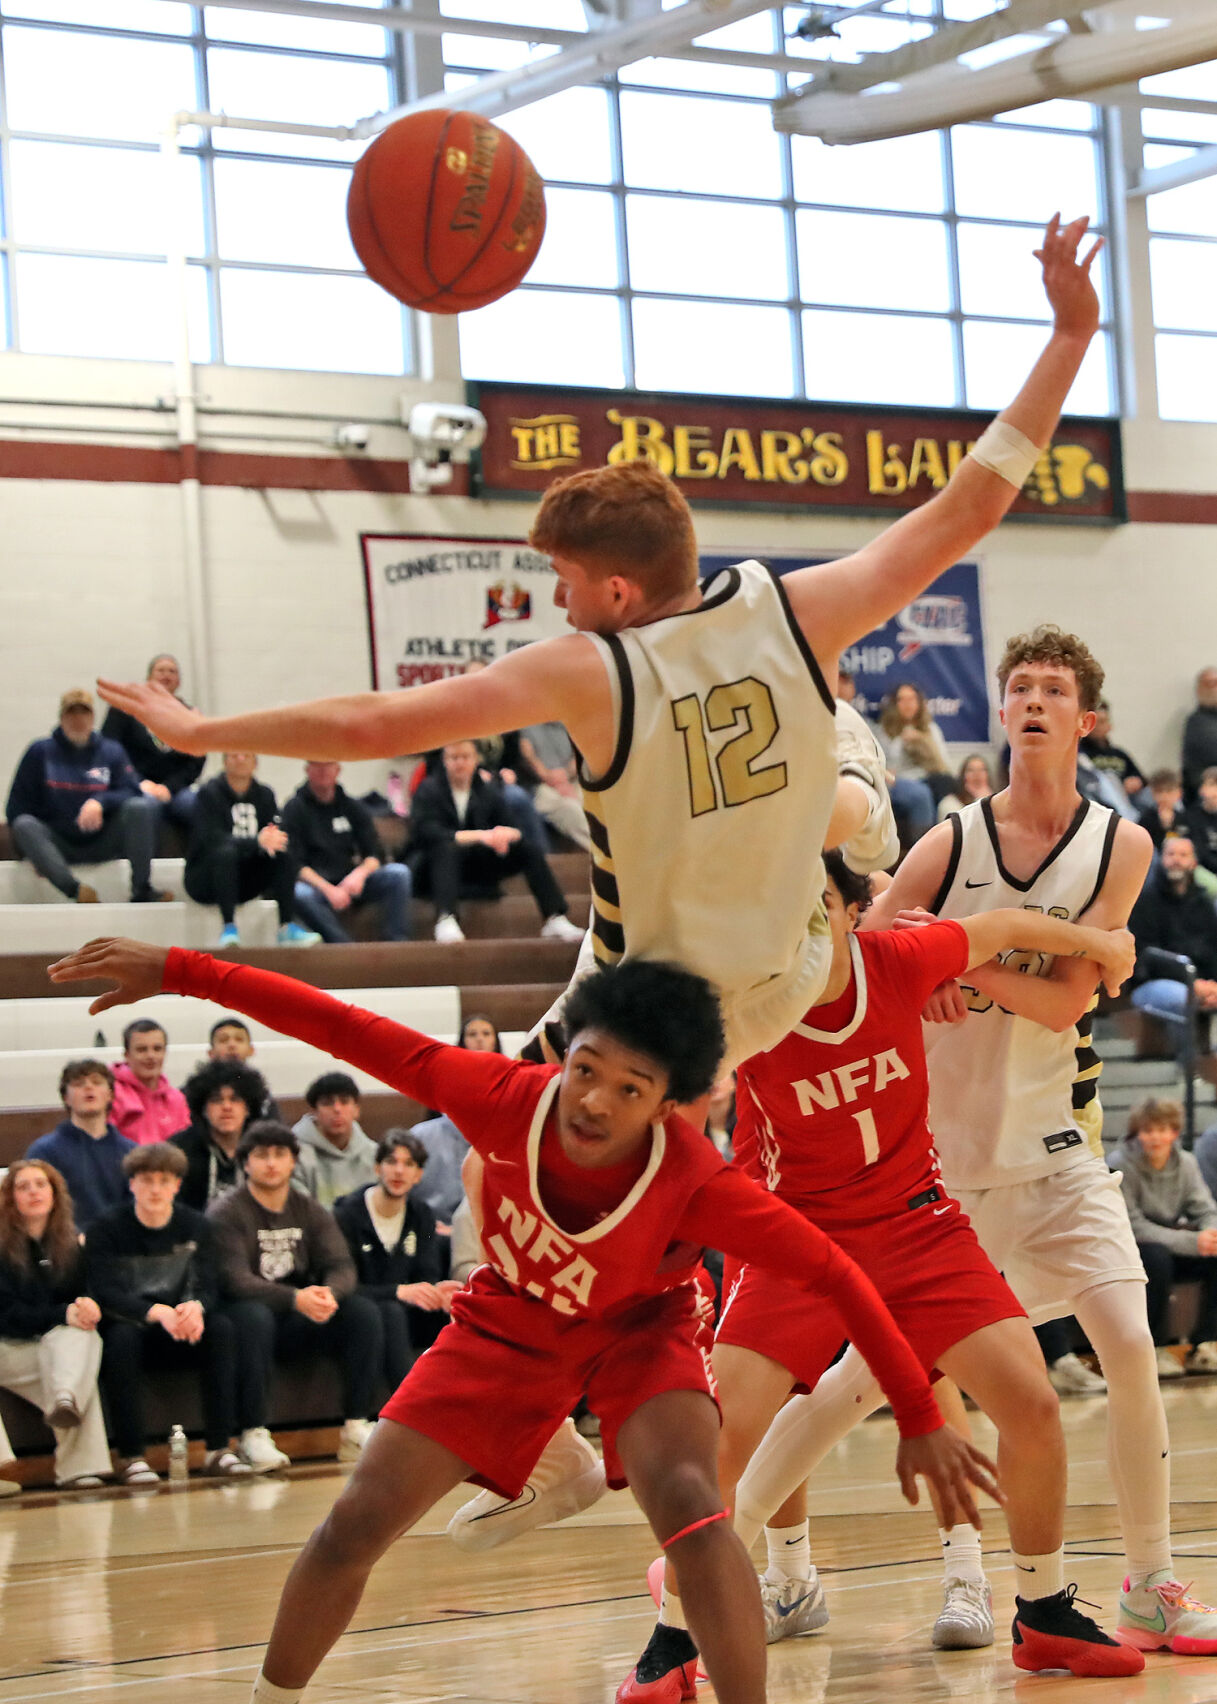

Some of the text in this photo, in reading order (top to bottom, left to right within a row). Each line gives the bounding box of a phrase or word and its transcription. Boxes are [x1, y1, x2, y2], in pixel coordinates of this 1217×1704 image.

[510, 423, 582, 463] THE
[606, 407, 850, 487] BEAR'S
[384, 550, 502, 585] CONNECTICUT
[405, 637, 496, 659] ATHLETIC
[670, 675, 788, 820] 12
[789, 1047, 911, 1116] NFA
[851, 1107, 880, 1167] 1
[497, 1195, 599, 1307] NFA
